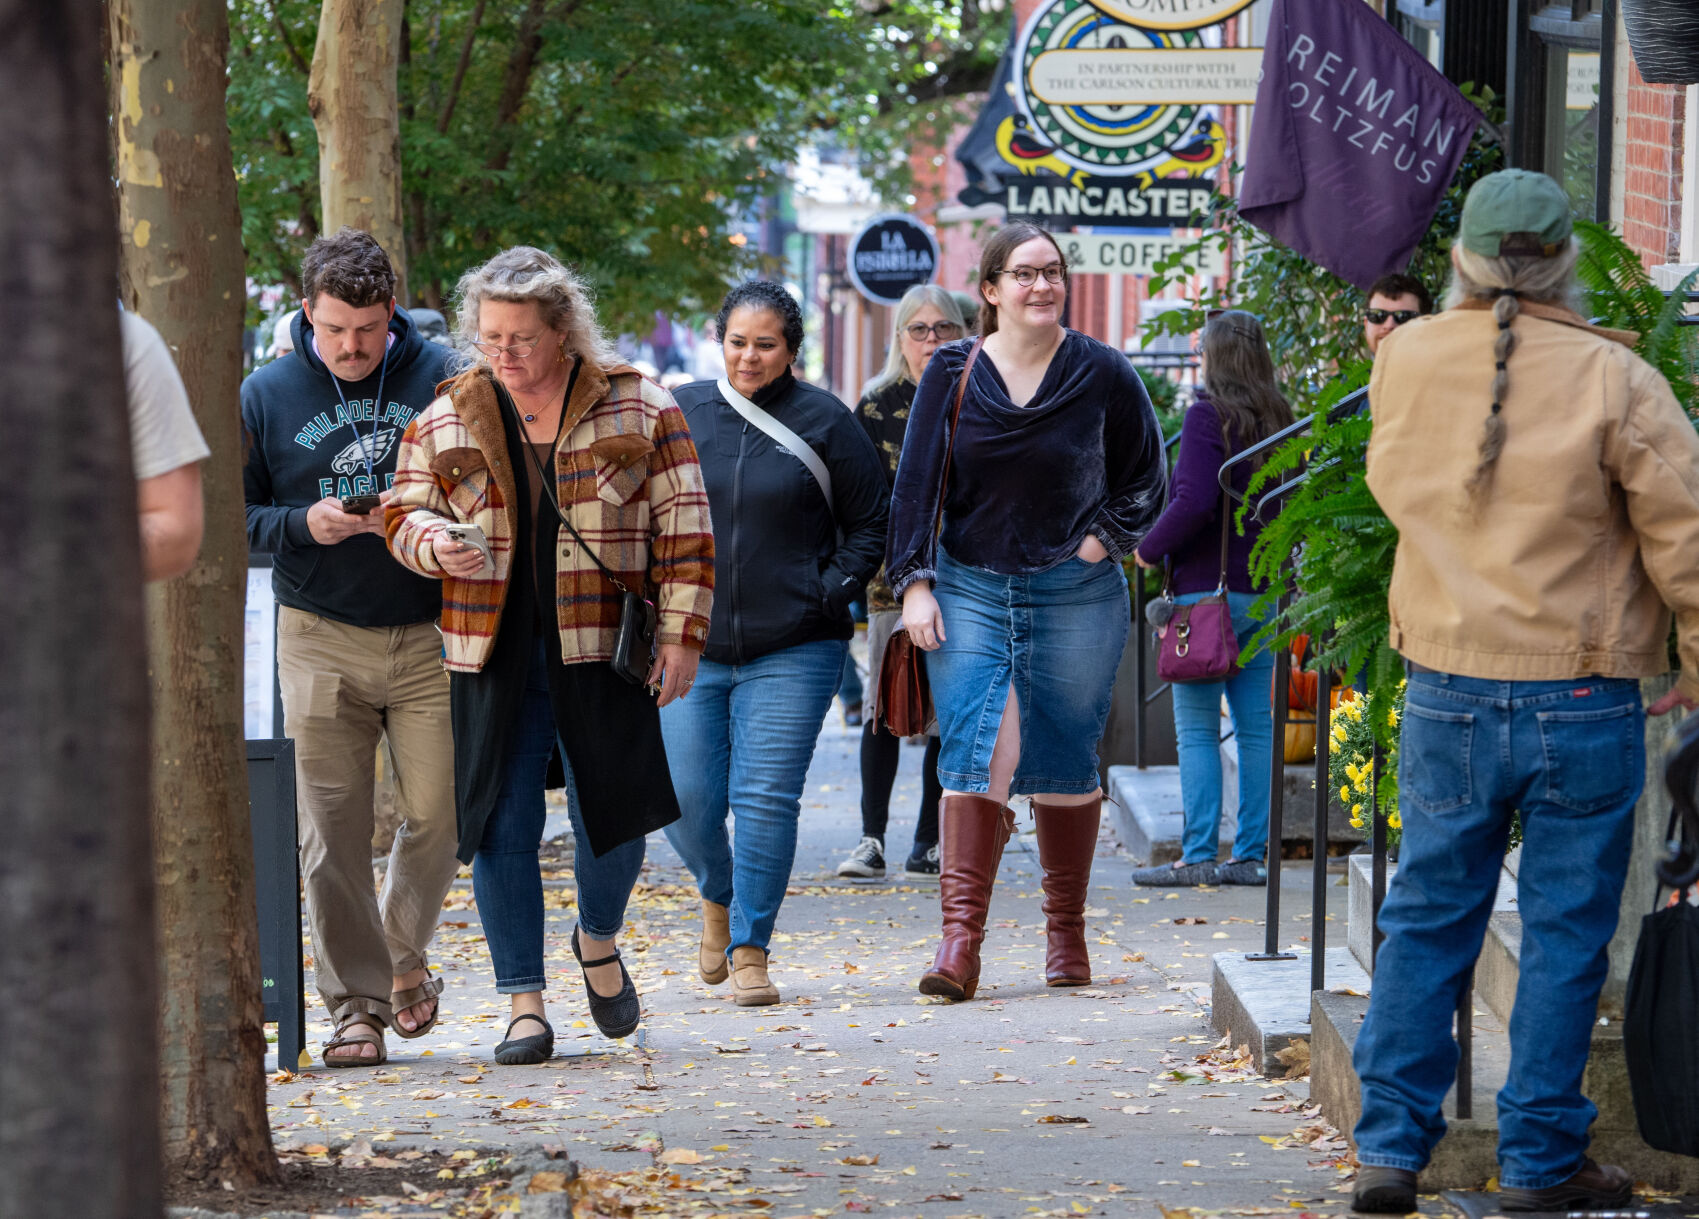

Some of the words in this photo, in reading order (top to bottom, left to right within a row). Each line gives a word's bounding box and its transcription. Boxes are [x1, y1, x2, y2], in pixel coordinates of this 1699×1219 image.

[1048, 78, 1076, 90] THE
[1079, 78, 1149, 90] CARLSON
[1152, 78, 1219, 90] CULTURAL
[1078, 63, 1095, 75] IN
[1098, 63, 1193, 75] PARTNERSHIP
[1194, 63, 1236, 75] WITH
[1287, 33, 1456, 156] REIMAN
[1289, 82, 1437, 184] OLTZFUS
[1007, 185, 1212, 217] LANCASTER
[881, 230, 907, 250] LA
[294, 398, 421, 451] PHILADELPHI
